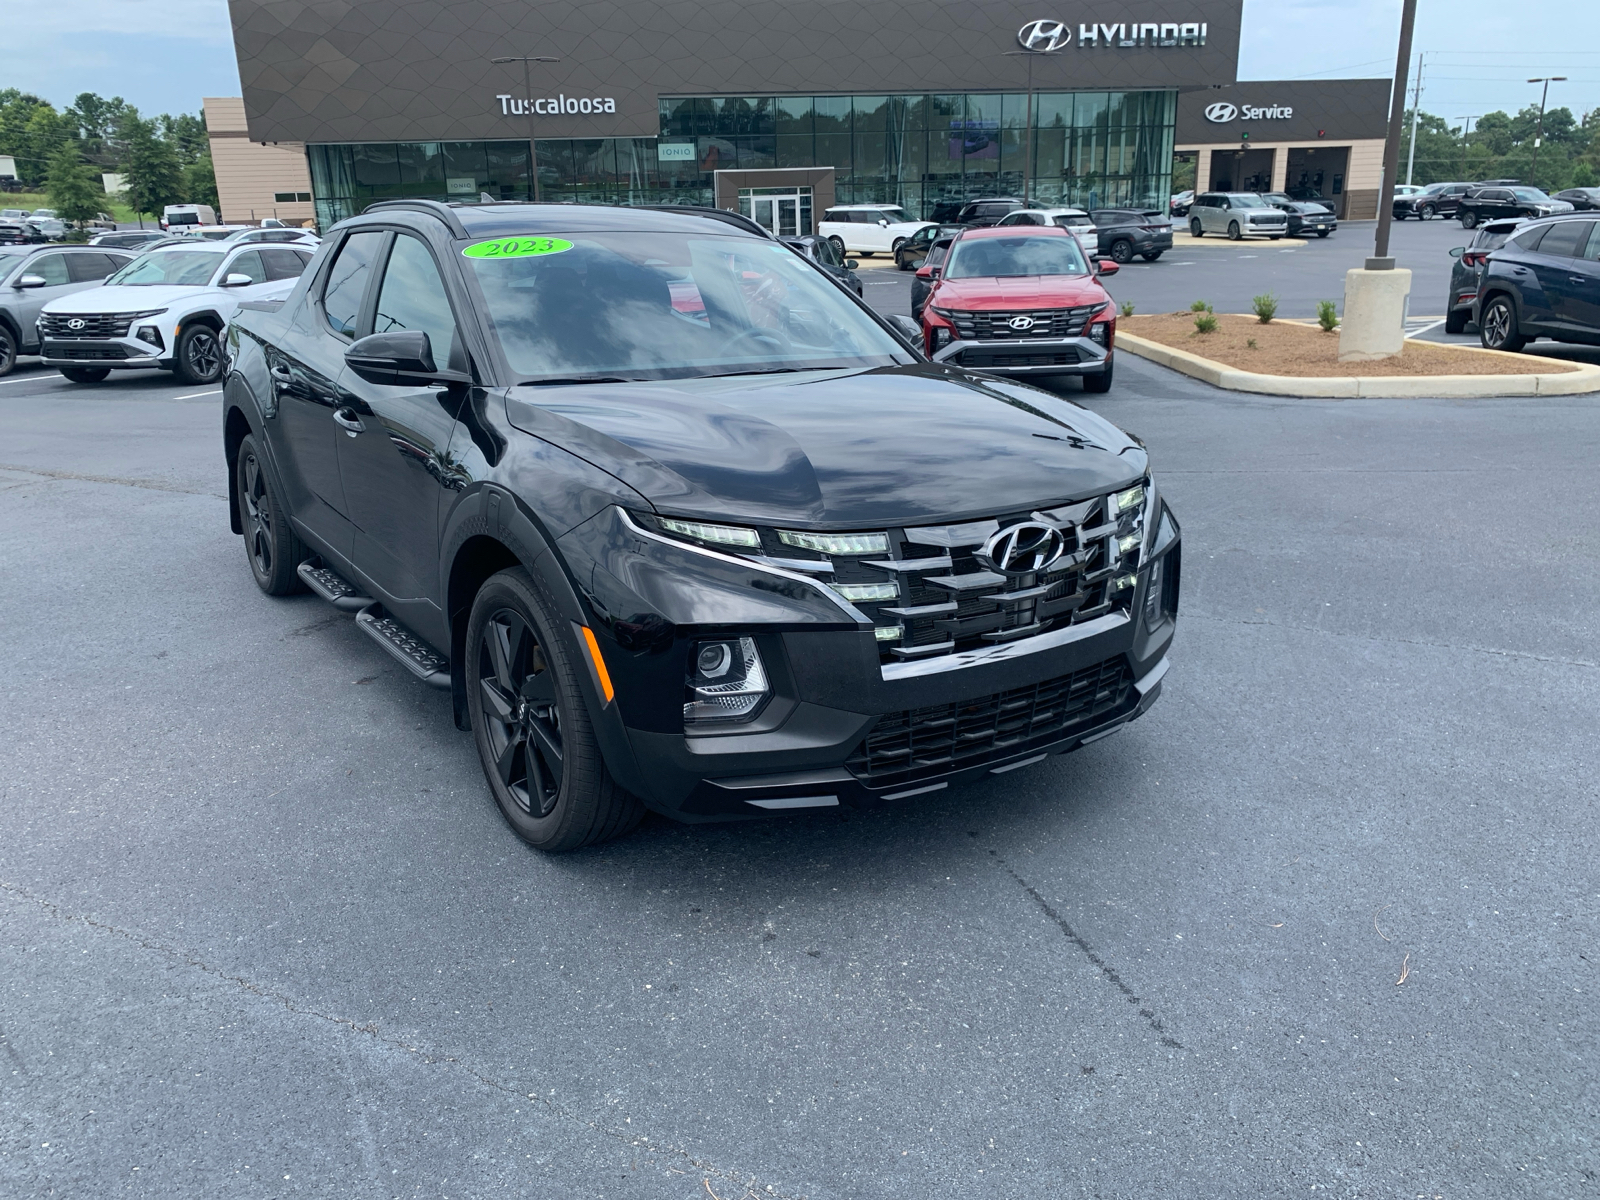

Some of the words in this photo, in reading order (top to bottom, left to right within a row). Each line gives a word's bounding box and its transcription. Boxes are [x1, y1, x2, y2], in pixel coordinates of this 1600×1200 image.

[1077, 22, 1207, 48] HYUNDAI
[496, 94, 616, 115] Tuscaloosa
[1240, 103, 1293, 120] Service
[484, 239, 554, 257] 2023
